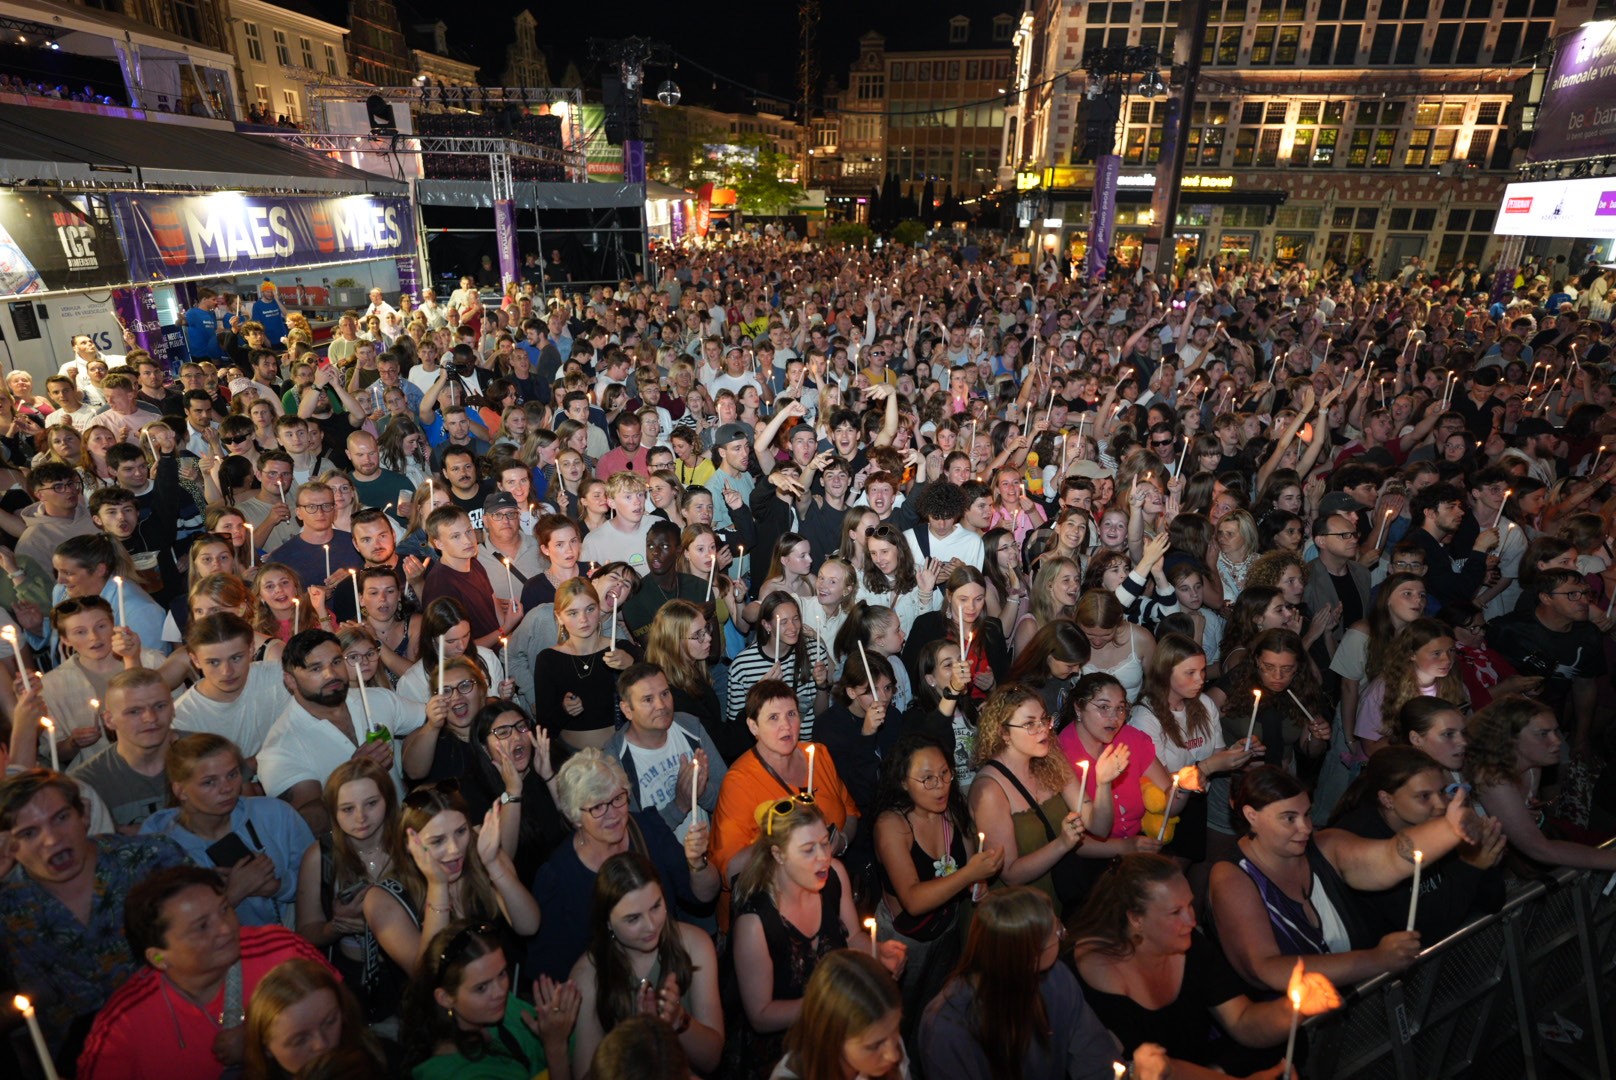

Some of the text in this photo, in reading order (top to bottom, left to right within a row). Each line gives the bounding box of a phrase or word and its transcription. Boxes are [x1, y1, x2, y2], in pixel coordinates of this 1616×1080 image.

[892, 60, 1008, 80] BASIC FIT
[57, 225, 95, 258] ICE
[184, 206, 295, 264] MAES
[333, 206, 402, 253] MAES
[640, 765, 659, 788] TOM
